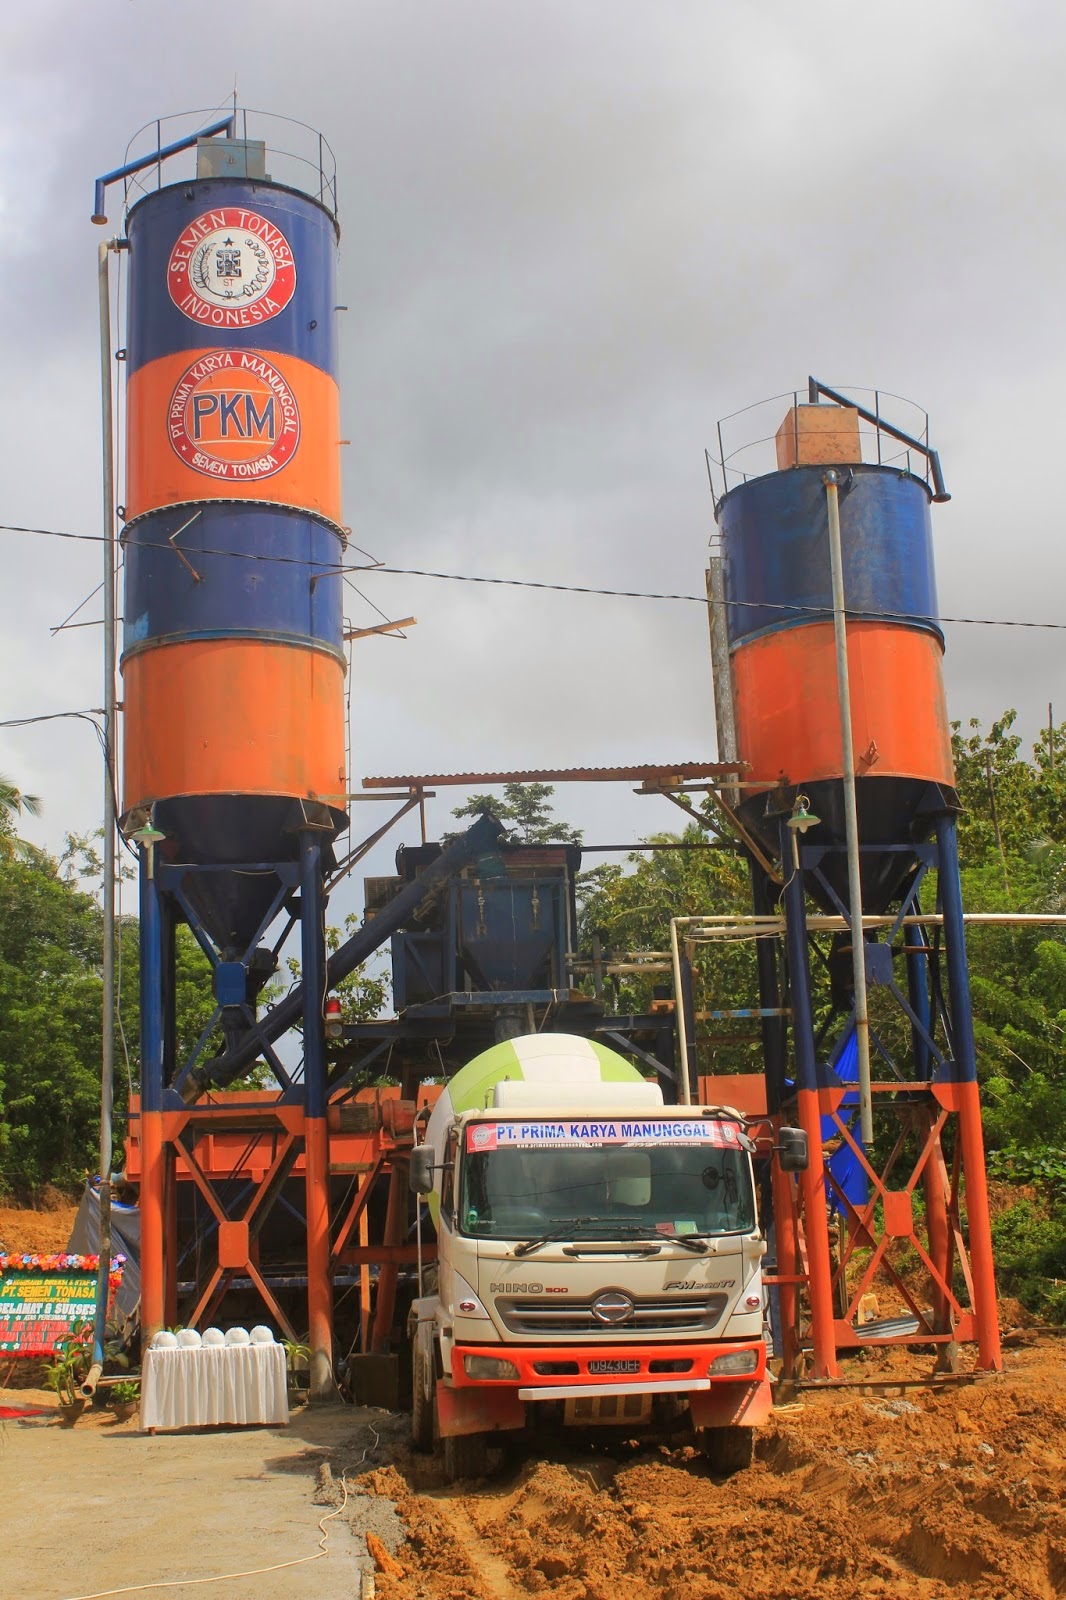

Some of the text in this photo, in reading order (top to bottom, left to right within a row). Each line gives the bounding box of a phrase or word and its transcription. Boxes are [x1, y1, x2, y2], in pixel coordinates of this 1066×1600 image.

[171, 211, 293, 272] SEMEN TONASA
[223, 279, 235, 287] ST
[180, 294, 280, 324] INDONESIA
[190, 353, 234, 381] KARYA
[241, 354, 297, 435] MANUNGGAL
[193, 393, 276, 440] PKM
[191, 452, 279, 477] SEMEN TONASA
[497, 1125, 517, 1139] PT.
[521, 1124, 566, 1139] PRIMA
[570, 1124, 617, 1138] KARYA
[621, 1123, 710, 1138] MANUNGGAL
[1, 1285, 96, 1298] PT. SEMEN TONASA
[490, 1283, 543, 1293] HINO
[54, 1303, 96, 1315] SUKSES
